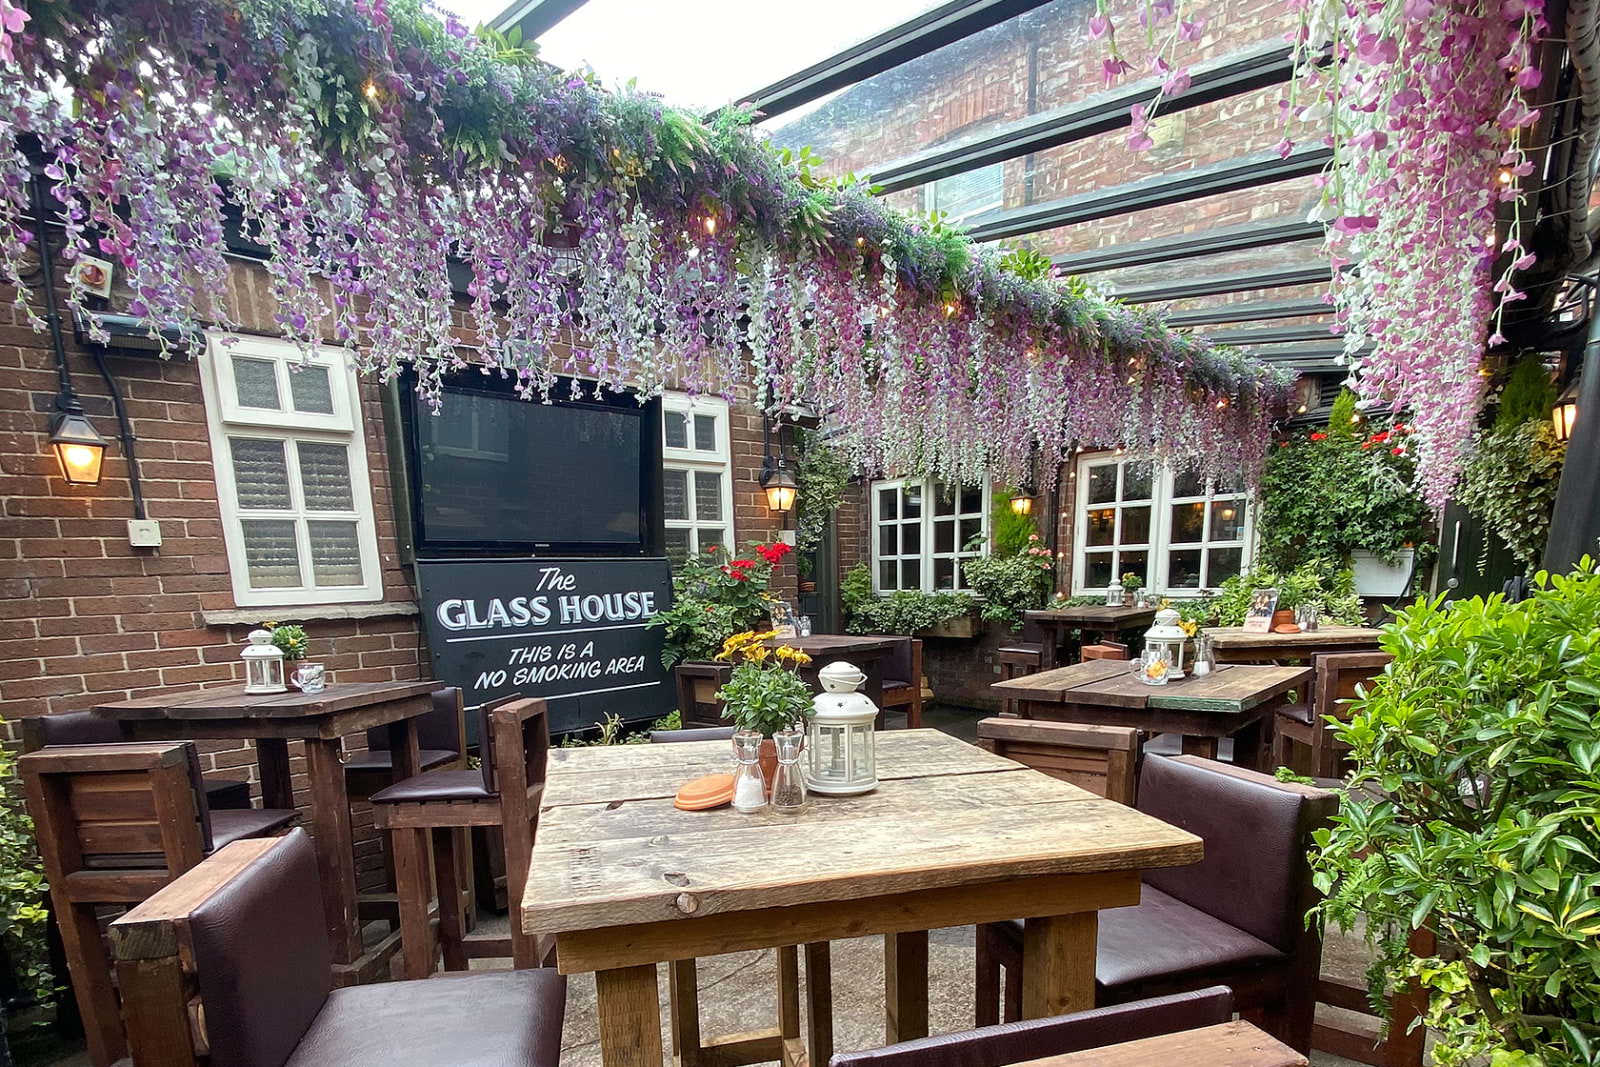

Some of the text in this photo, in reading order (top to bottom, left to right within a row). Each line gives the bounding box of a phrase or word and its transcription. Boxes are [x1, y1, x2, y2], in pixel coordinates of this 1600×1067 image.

[535, 567, 577, 592] The
[436, 591, 659, 631] GLASS HOUSE
[508, 641, 594, 665] THIS IS A
[473, 655, 645, 690] NO SMOKING AREA
